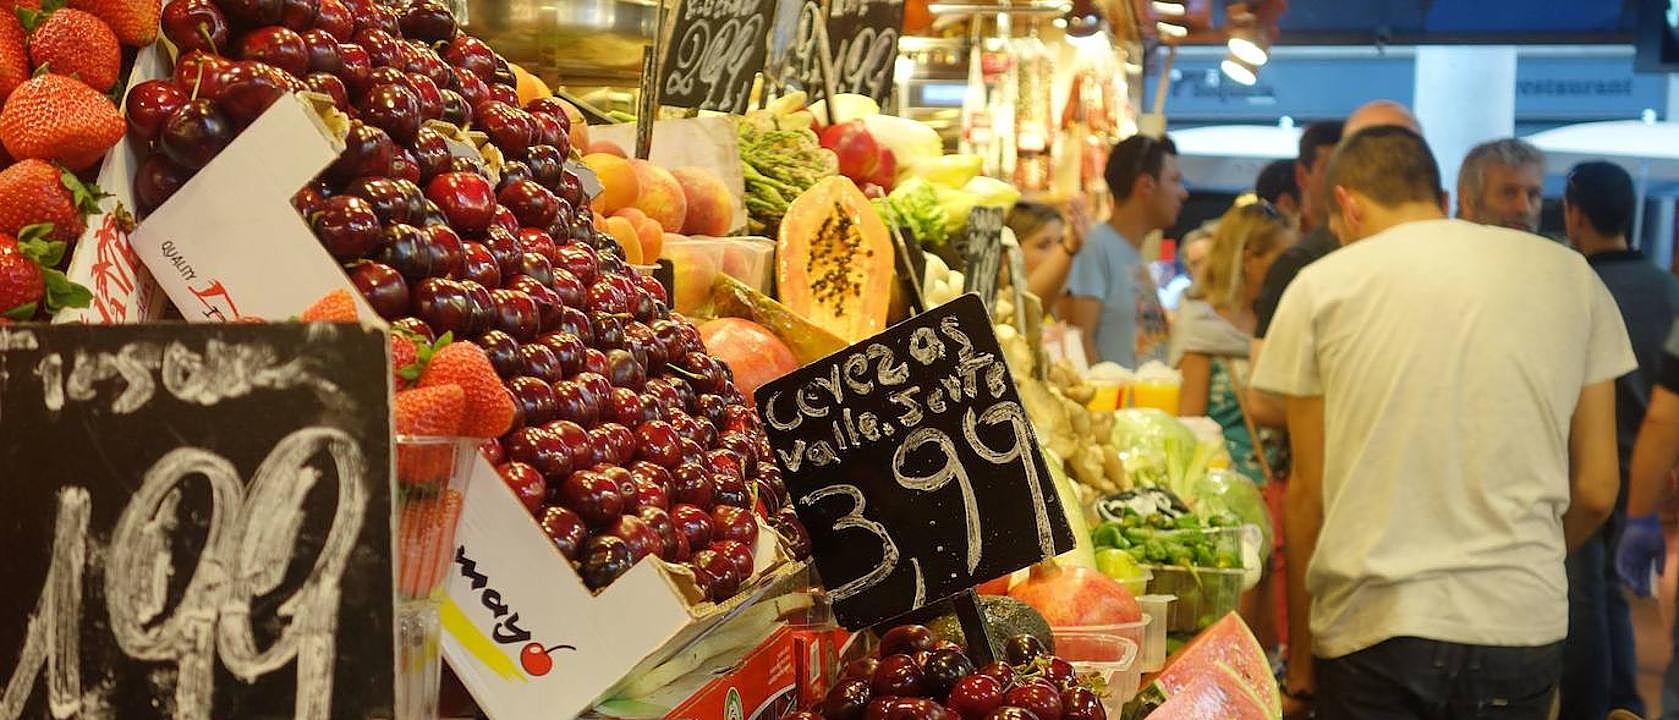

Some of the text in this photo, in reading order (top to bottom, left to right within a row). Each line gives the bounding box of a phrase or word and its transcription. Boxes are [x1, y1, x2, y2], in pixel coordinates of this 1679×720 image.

[161, 240, 198, 281] QUALITY
[800, 401, 1056, 610] 3,99
[455, 545, 532, 644] may
